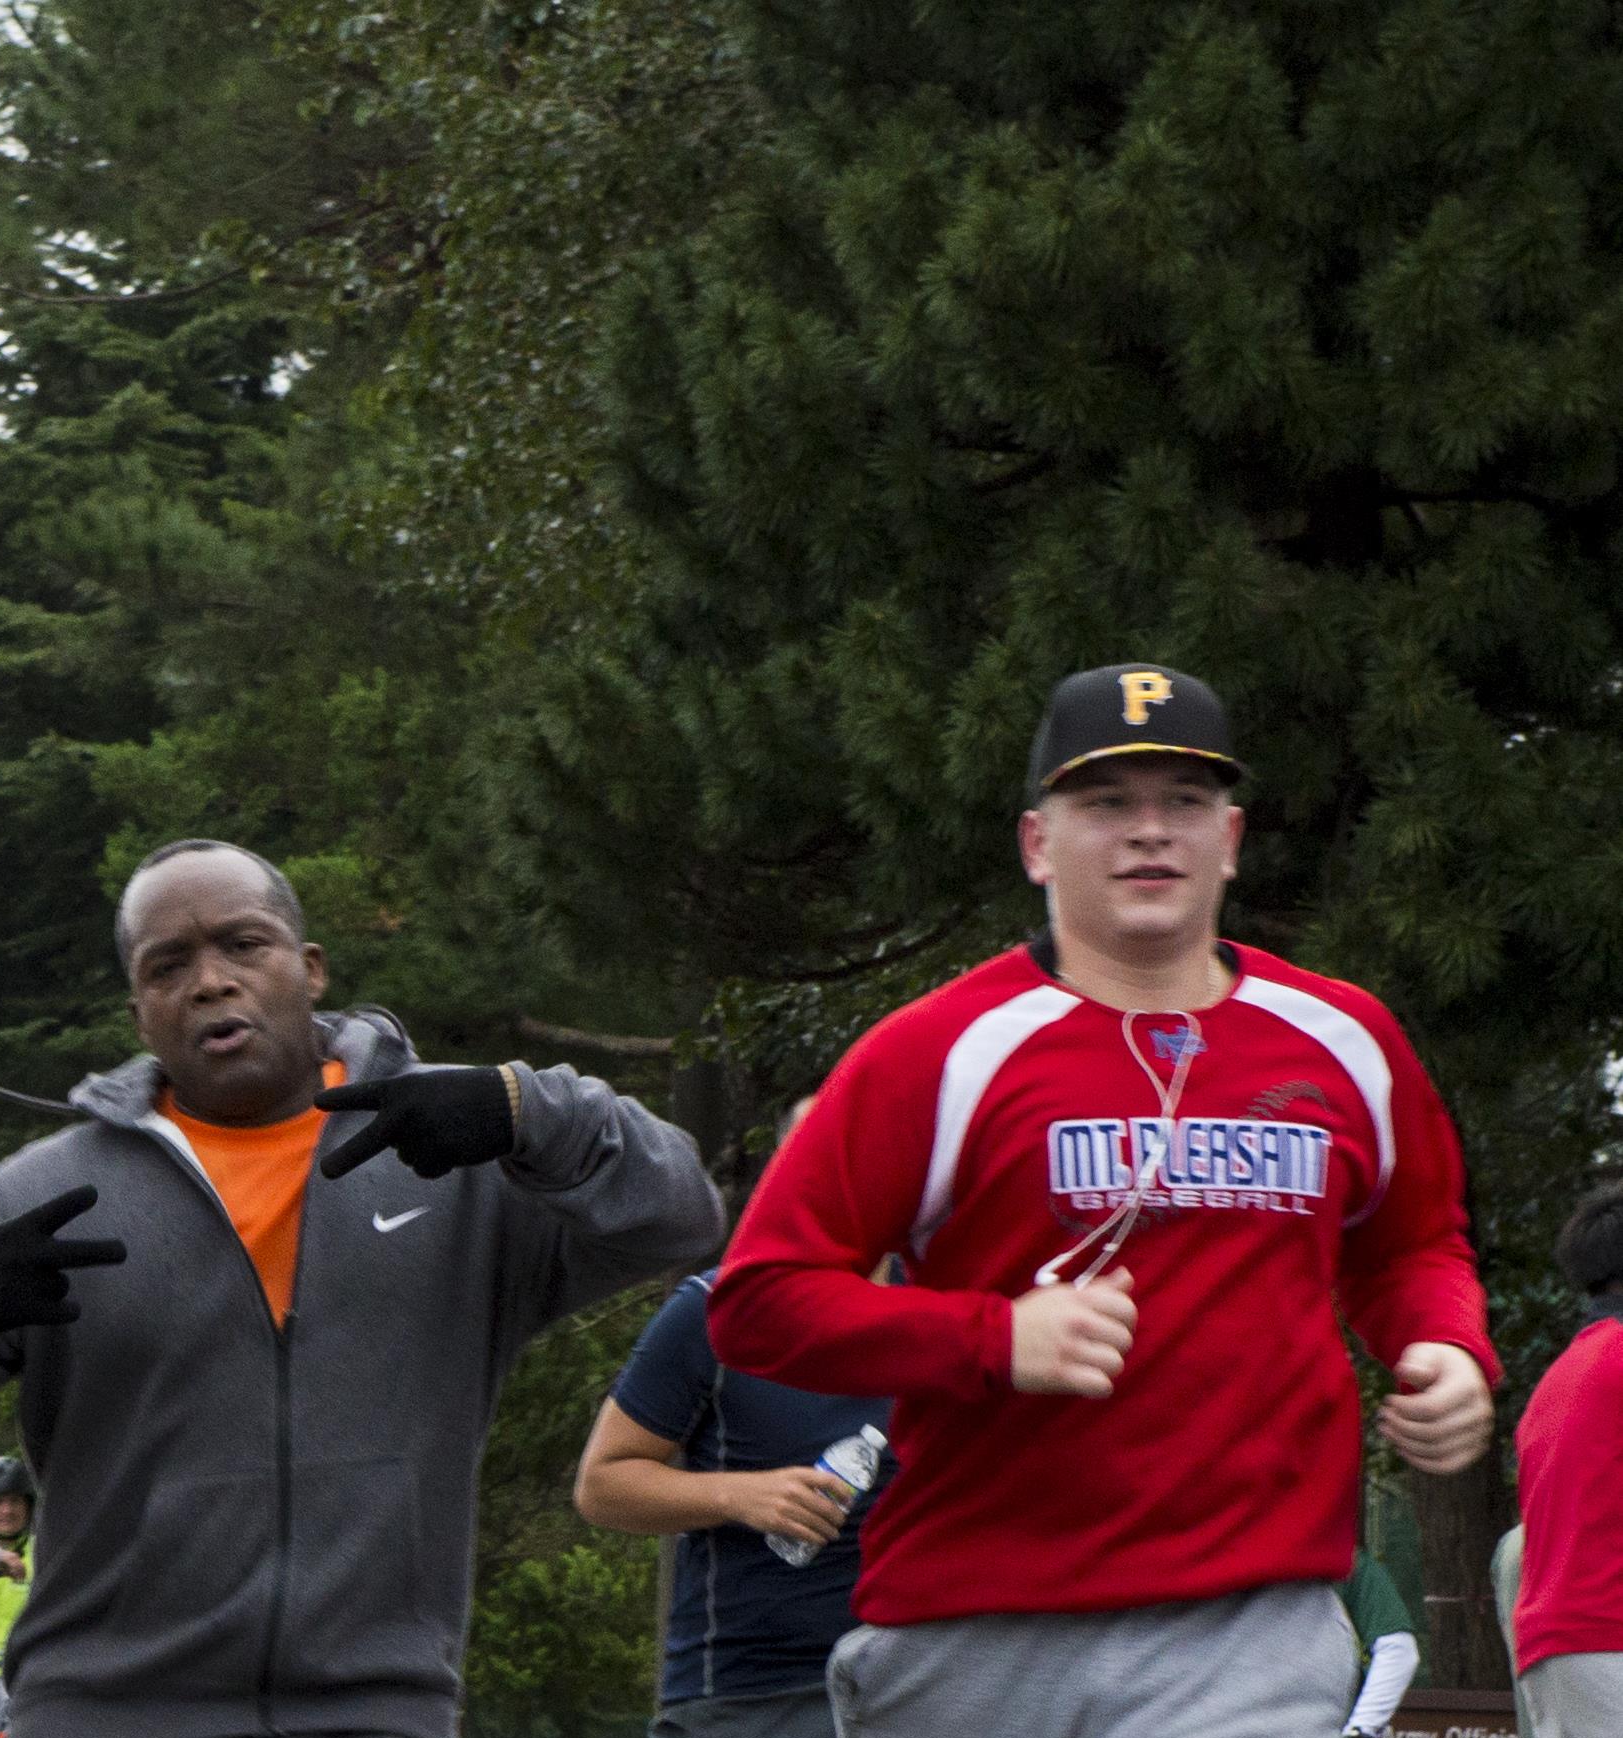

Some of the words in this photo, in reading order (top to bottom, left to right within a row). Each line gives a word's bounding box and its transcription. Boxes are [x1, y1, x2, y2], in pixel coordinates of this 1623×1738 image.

[1118, 671, 1174, 725] P
[1128, 1117, 1333, 1198] PLEASANT
[1070, 1188, 1315, 1215] BASEBALL
